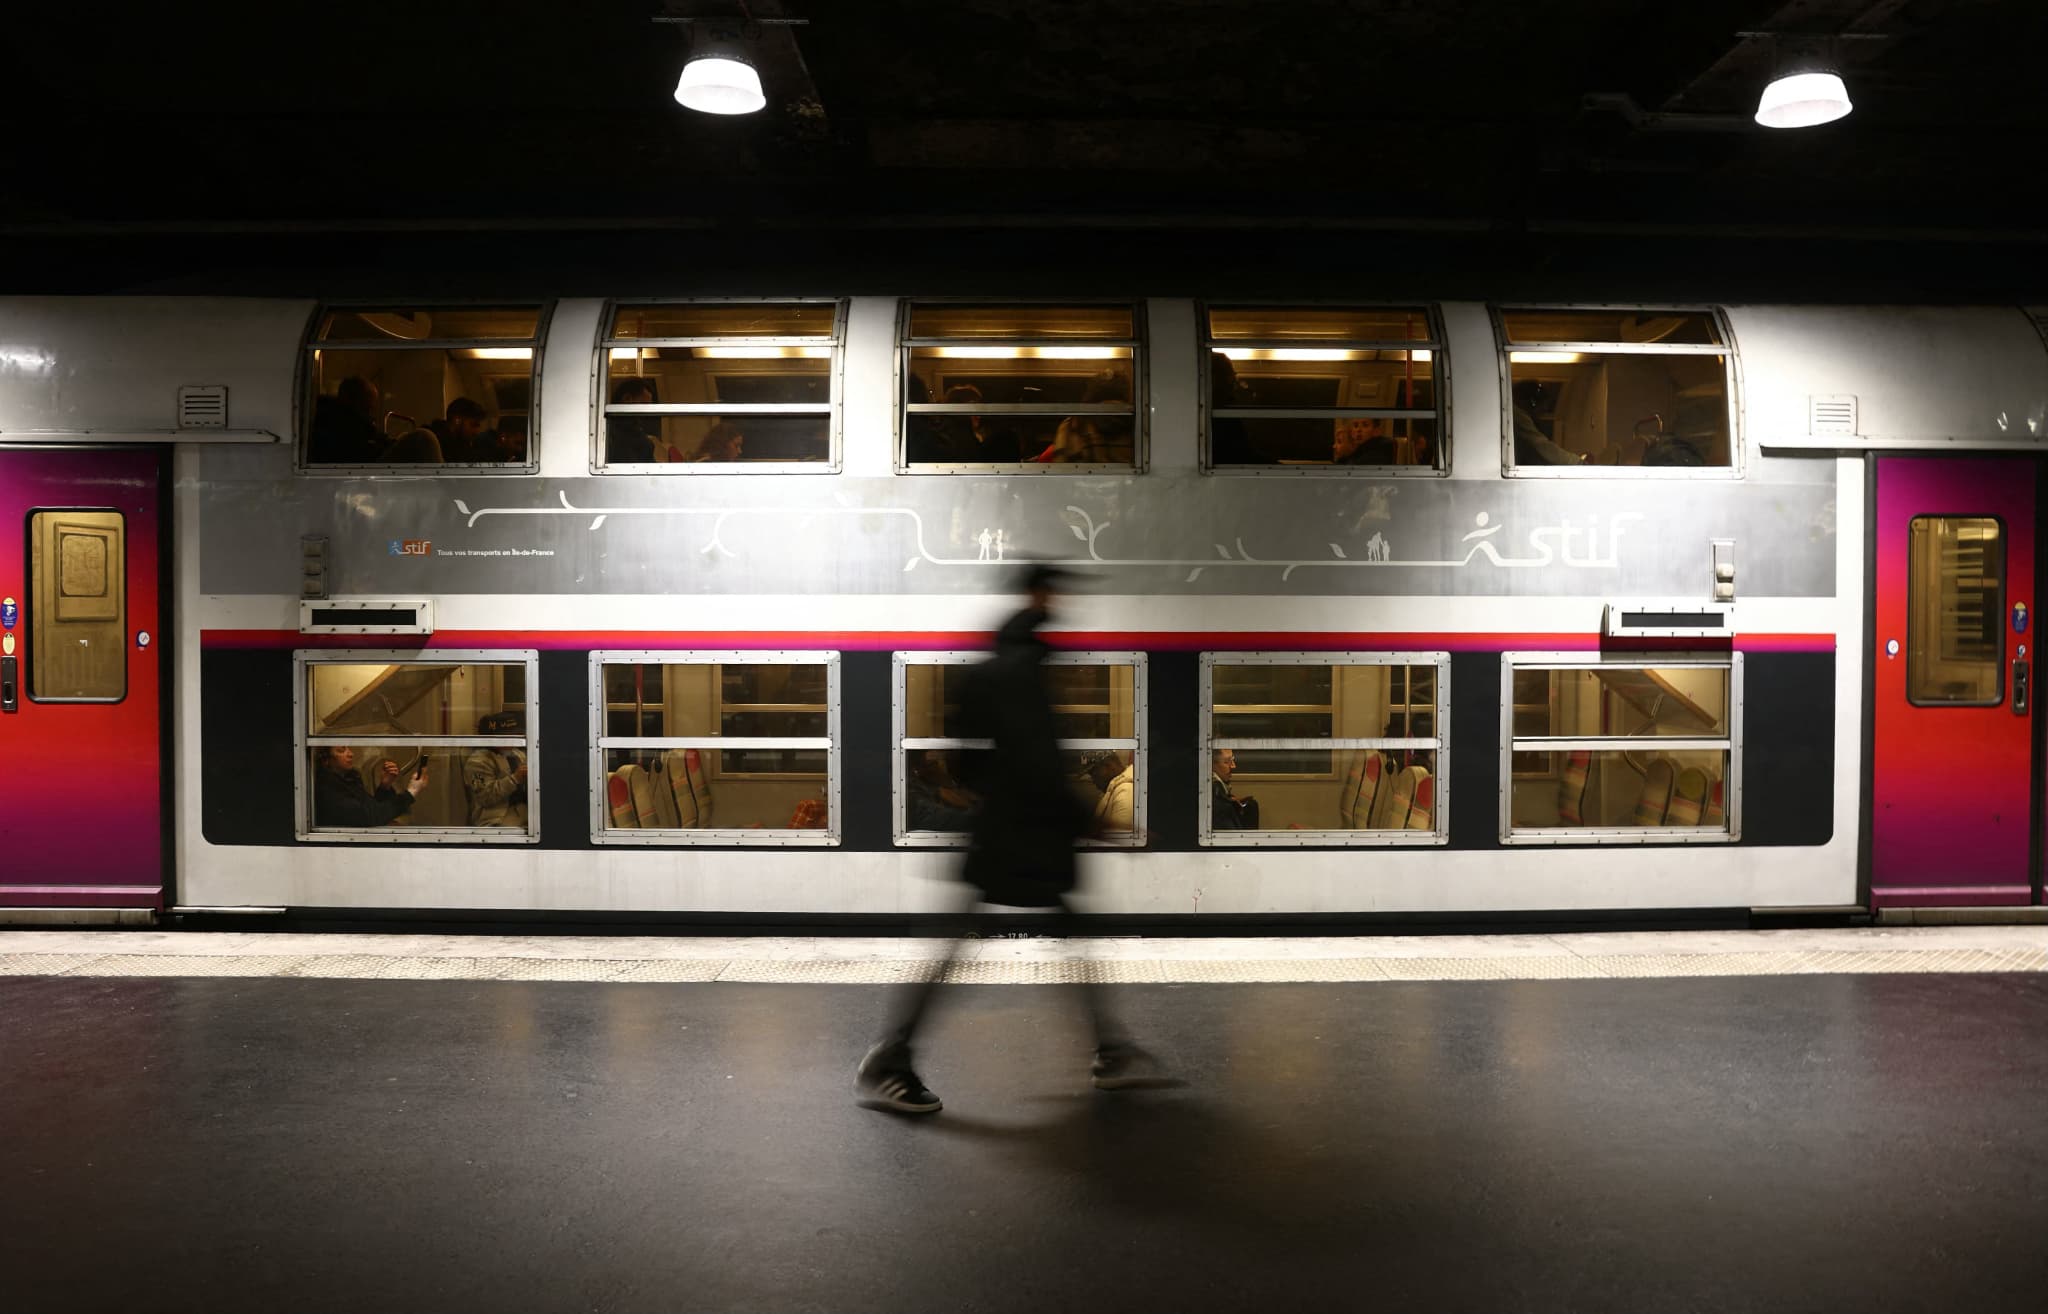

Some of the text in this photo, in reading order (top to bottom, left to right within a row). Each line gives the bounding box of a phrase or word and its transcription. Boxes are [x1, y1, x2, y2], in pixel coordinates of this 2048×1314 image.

[1529, 511, 1646, 567] stif
[405, 541, 431, 555] stif
[437, 549, 453, 557] Tous
[467, 549, 501, 558] transports
